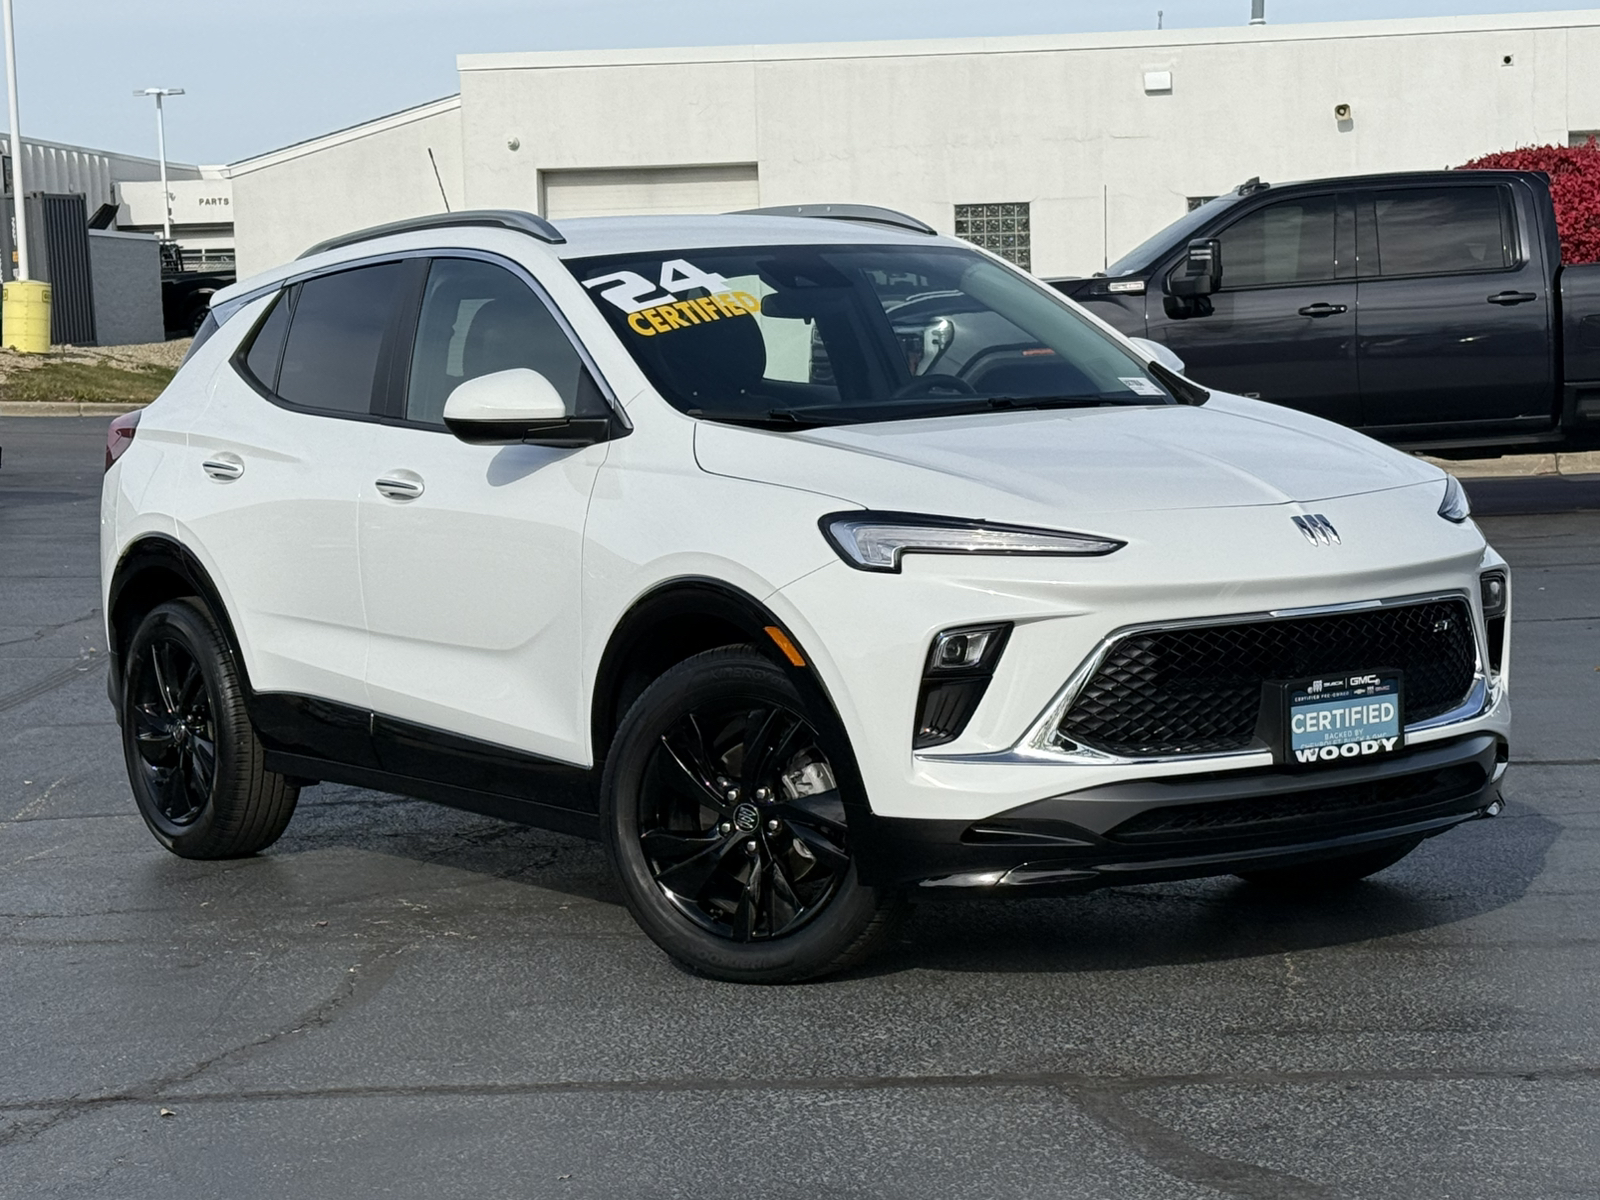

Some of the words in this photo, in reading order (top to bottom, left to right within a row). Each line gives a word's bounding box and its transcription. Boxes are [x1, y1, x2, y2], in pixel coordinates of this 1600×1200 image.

[199, 197, 229, 206] PARTS
[581, 258, 732, 314] 24
[627, 290, 761, 336] CERTIFIED
[1350, 674, 1377, 686] GMC
[1294, 694, 1320, 703] CERTIFIED
[1291, 702, 1395, 734] CERTIFIED
[1324, 730, 1353, 741] BACKED
[1354, 728, 1364, 737] BY
[1294, 736, 1399, 763] WOODY
